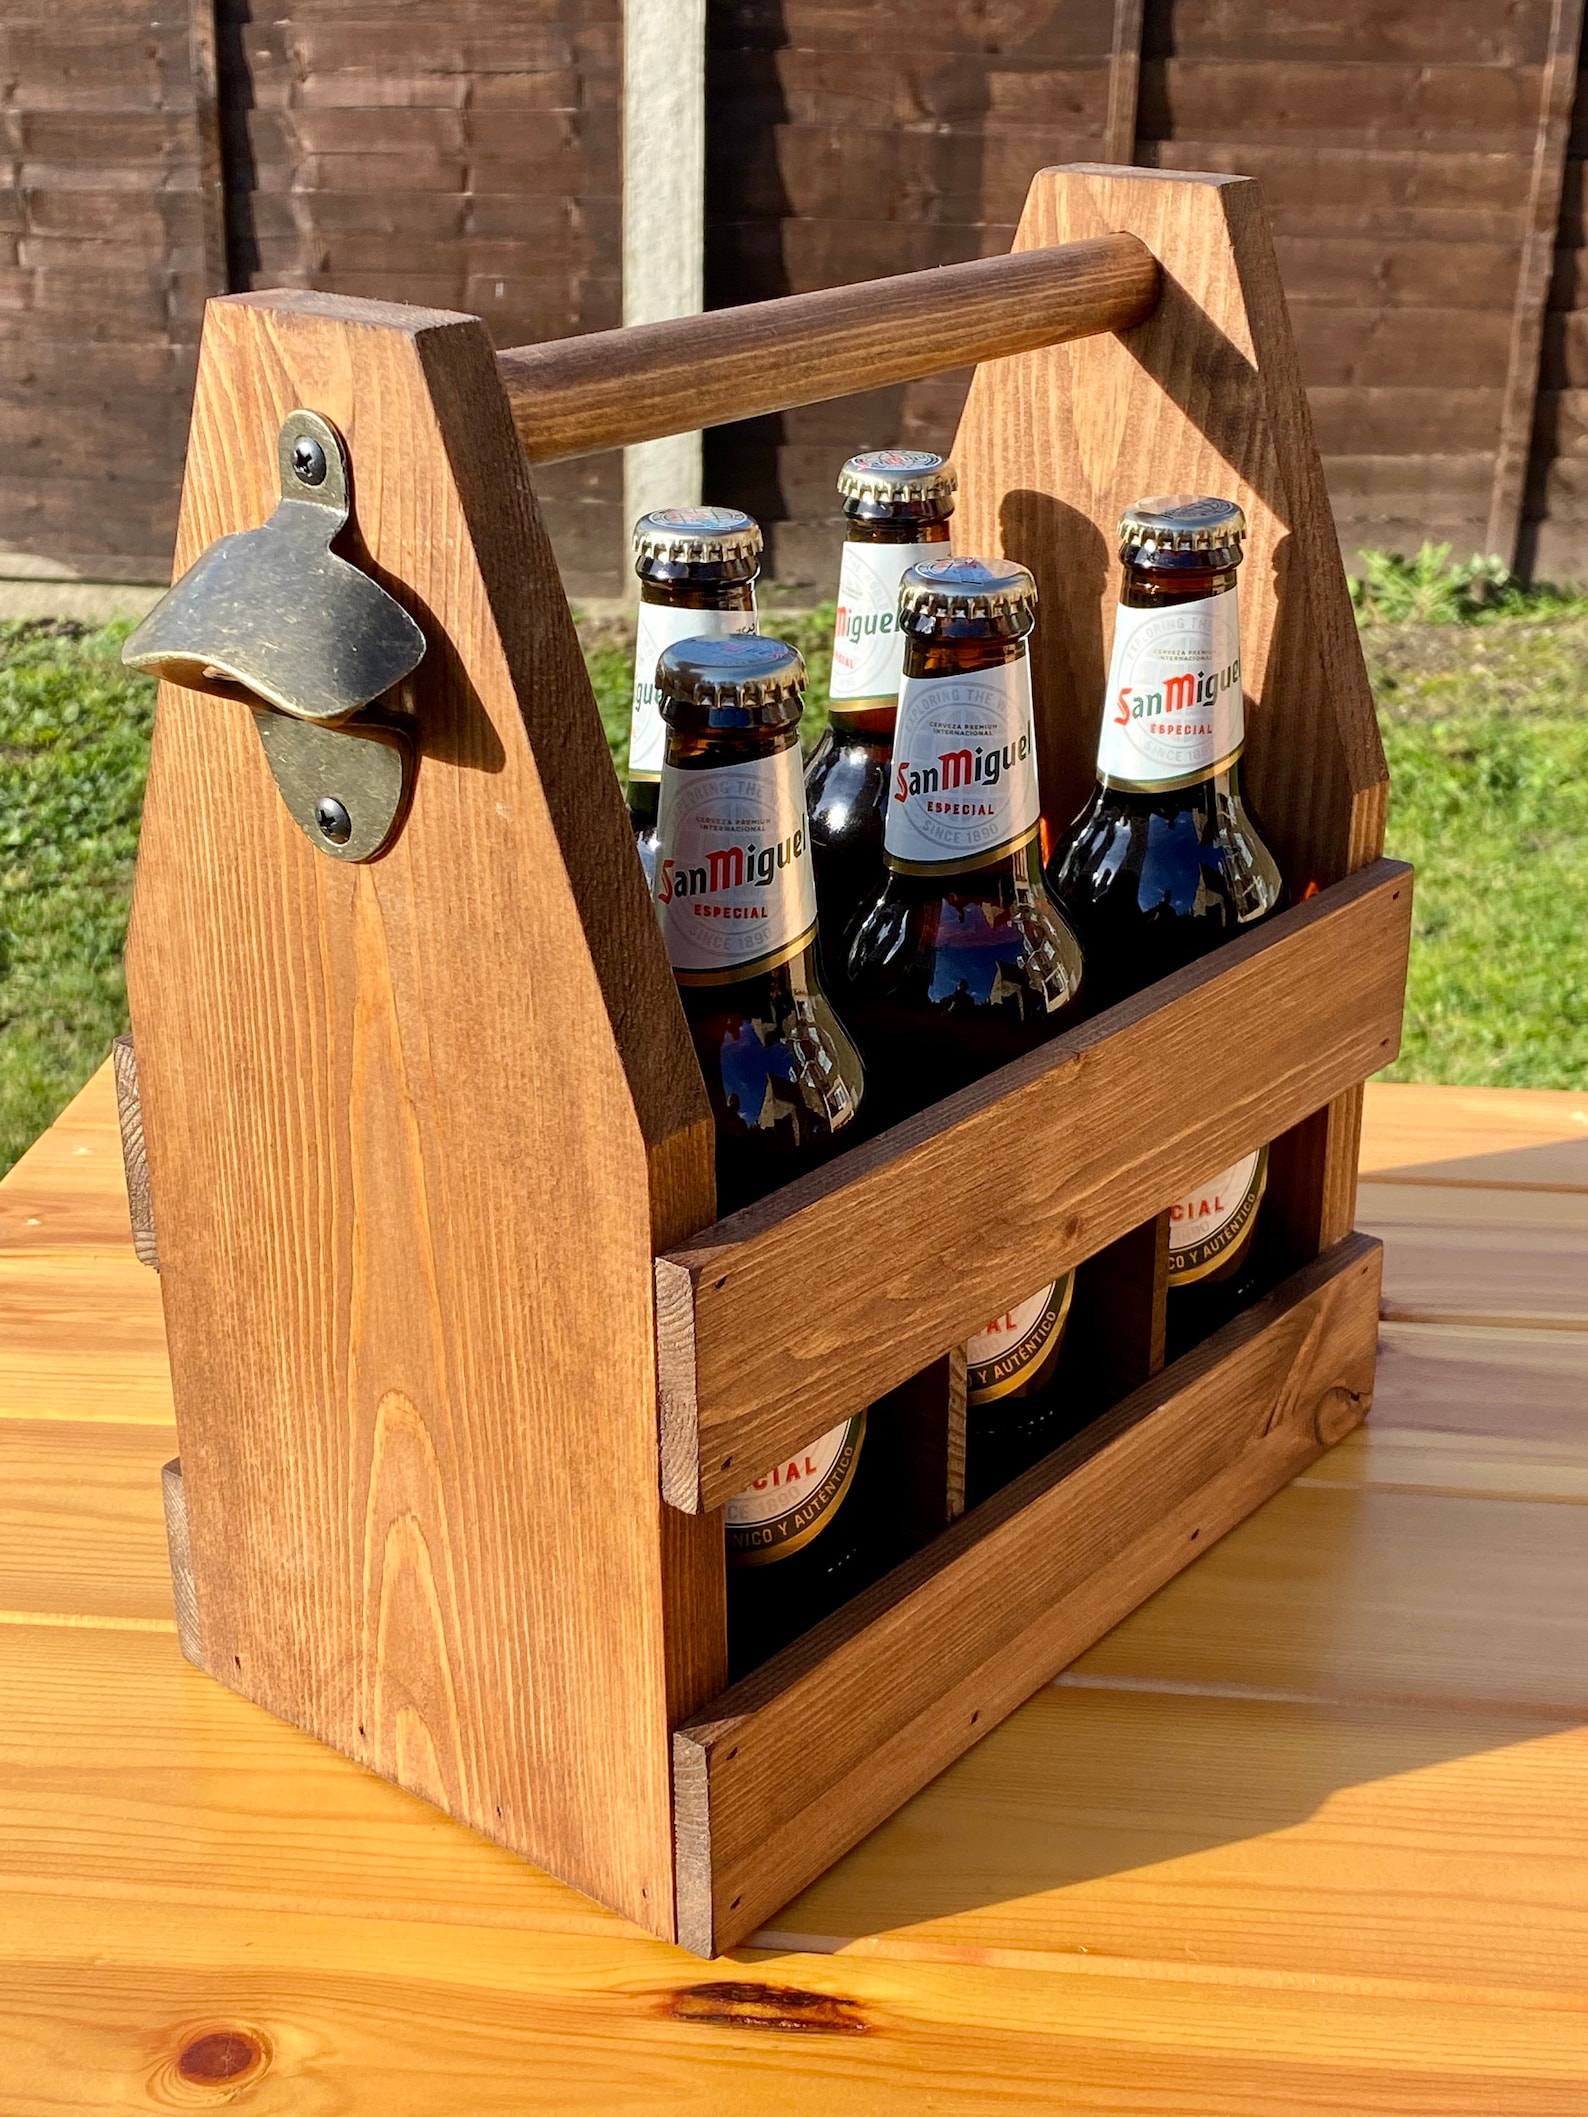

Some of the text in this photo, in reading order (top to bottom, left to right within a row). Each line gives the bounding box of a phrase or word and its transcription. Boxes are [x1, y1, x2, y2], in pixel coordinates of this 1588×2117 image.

[905, 689, 960, 733] EXPLORING
[967, 689, 993, 704] THE
[929, 721, 962, 730] CERVEZA
[933, 728, 994, 737] INTERNACIONAL
[1150, 724, 1213, 735] ESPECIAL
[927, 801, 995, 815] ESPECIAL
[922, 821, 999, 843] SINCE 1890
[694, 904, 768, 919] ESPECIAL
[1203, 1193, 1256, 1258] AUTÉNTICO
[994, 1311, 1056, 1379] AUTÉNTICO
[778, 1521, 788, 1536] Y
[794, 1446, 854, 1529] AUTÉNTICO
